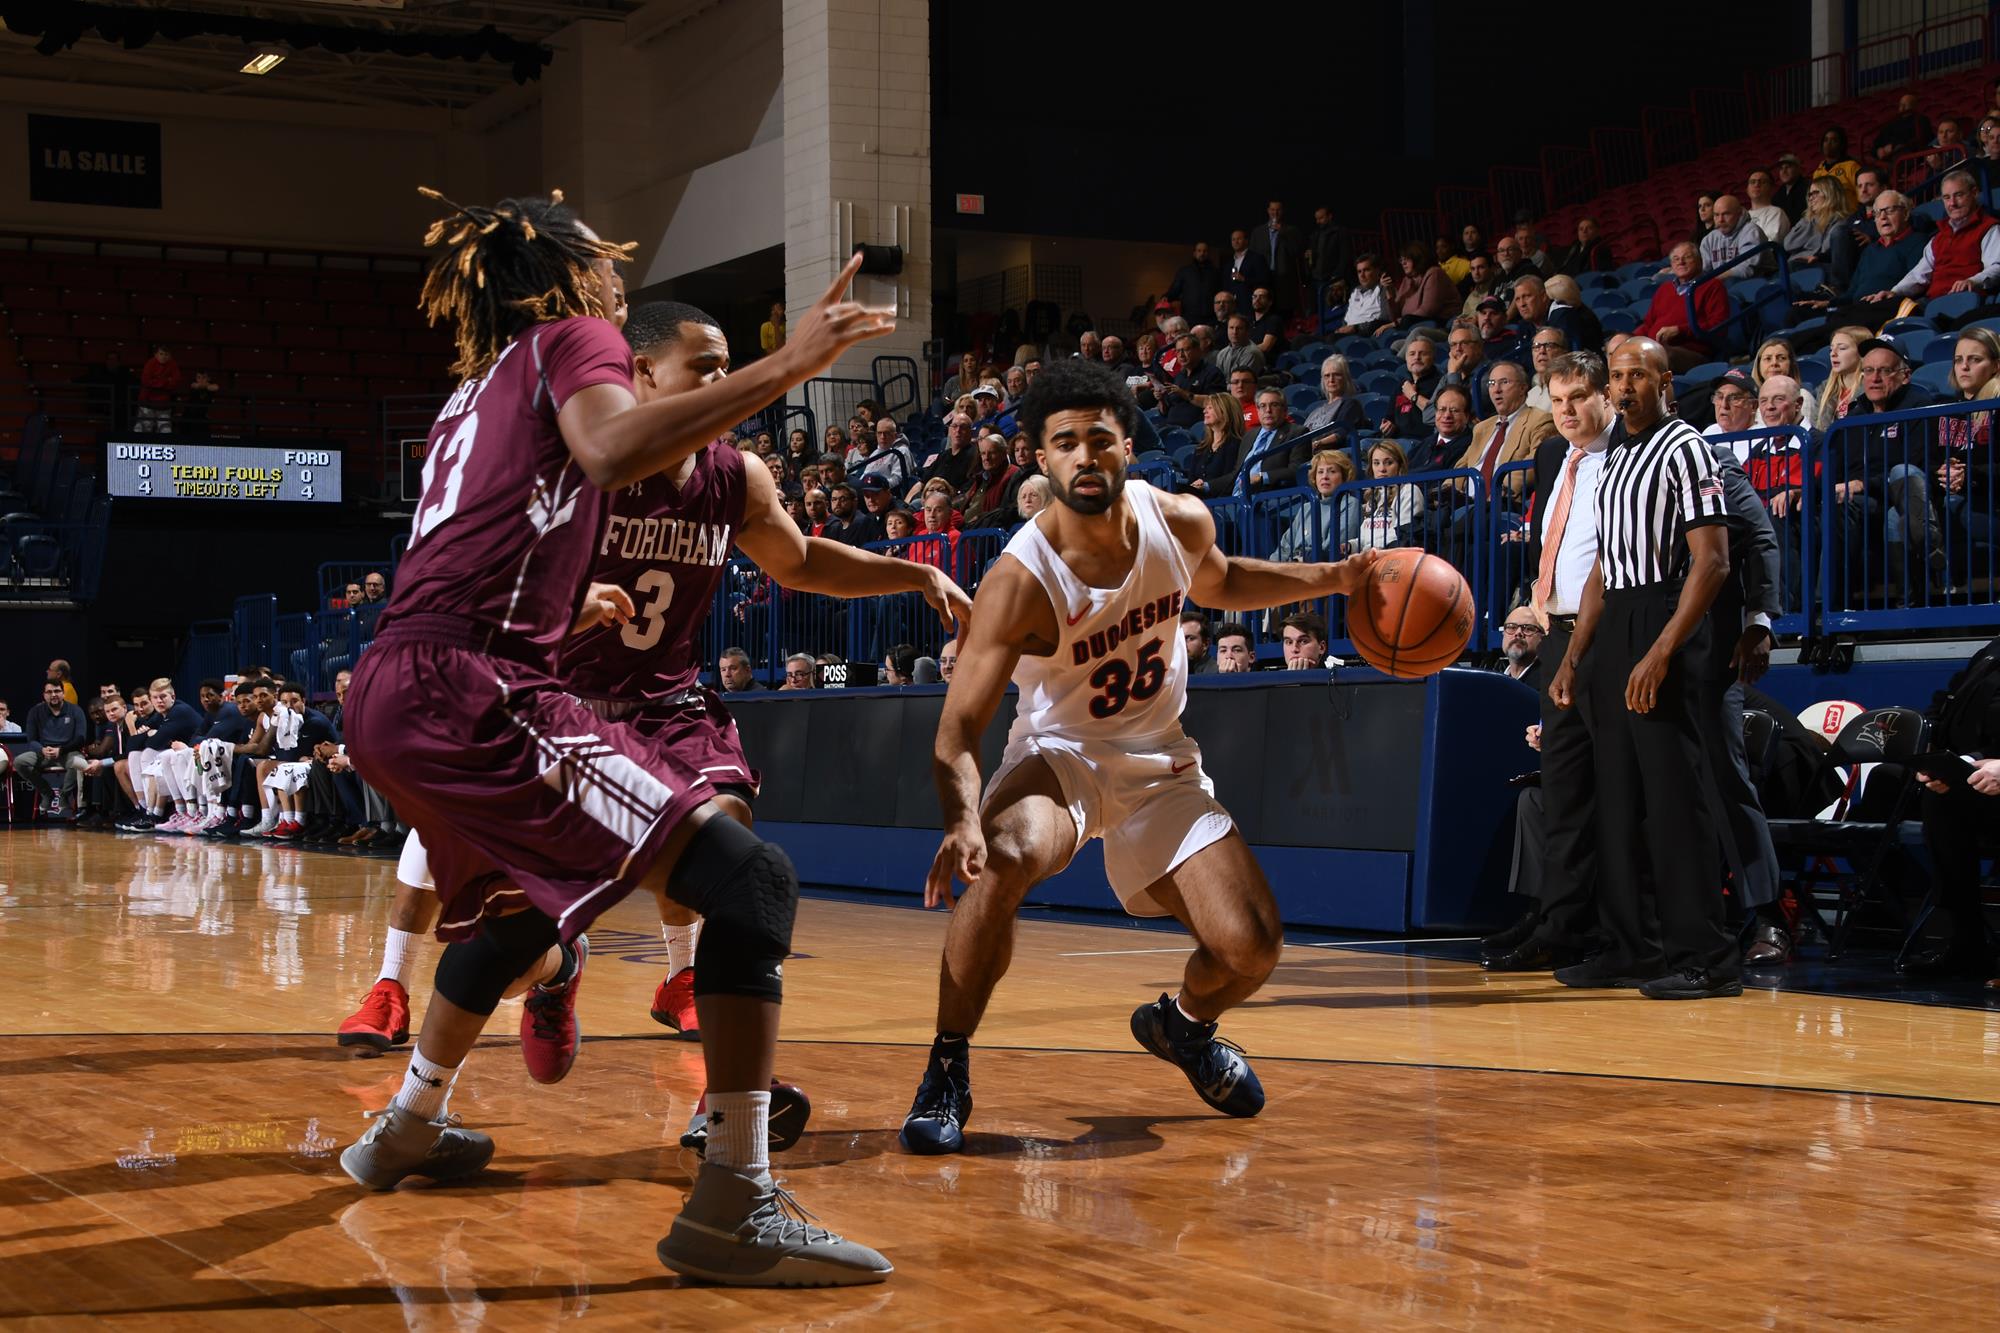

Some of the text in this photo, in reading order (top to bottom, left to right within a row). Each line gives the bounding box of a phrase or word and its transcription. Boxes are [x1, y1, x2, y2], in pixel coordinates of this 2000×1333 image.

[44, 148, 147, 175] LA SALLE
[116, 445, 176, 461] DUKES
[284, 450, 330, 466] FORD
[410, 444, 426, 458] DU
[138, 464, 151, 478] 0
[171, 465, 283, 482] TEAM FOULS
[300, 469, 313, 483] 0
[138, 480, 153, 495] 4
[174, 482, 279, 498] TIMEOUTS LEFT
[300, 485, 314, 499] 4
[600, 513, 731, 567] FORDHAM
[619, 568, 675, 651] 3
[823, 664, 847, 682] POSS
[1088, 636, 1168, 720] 35
